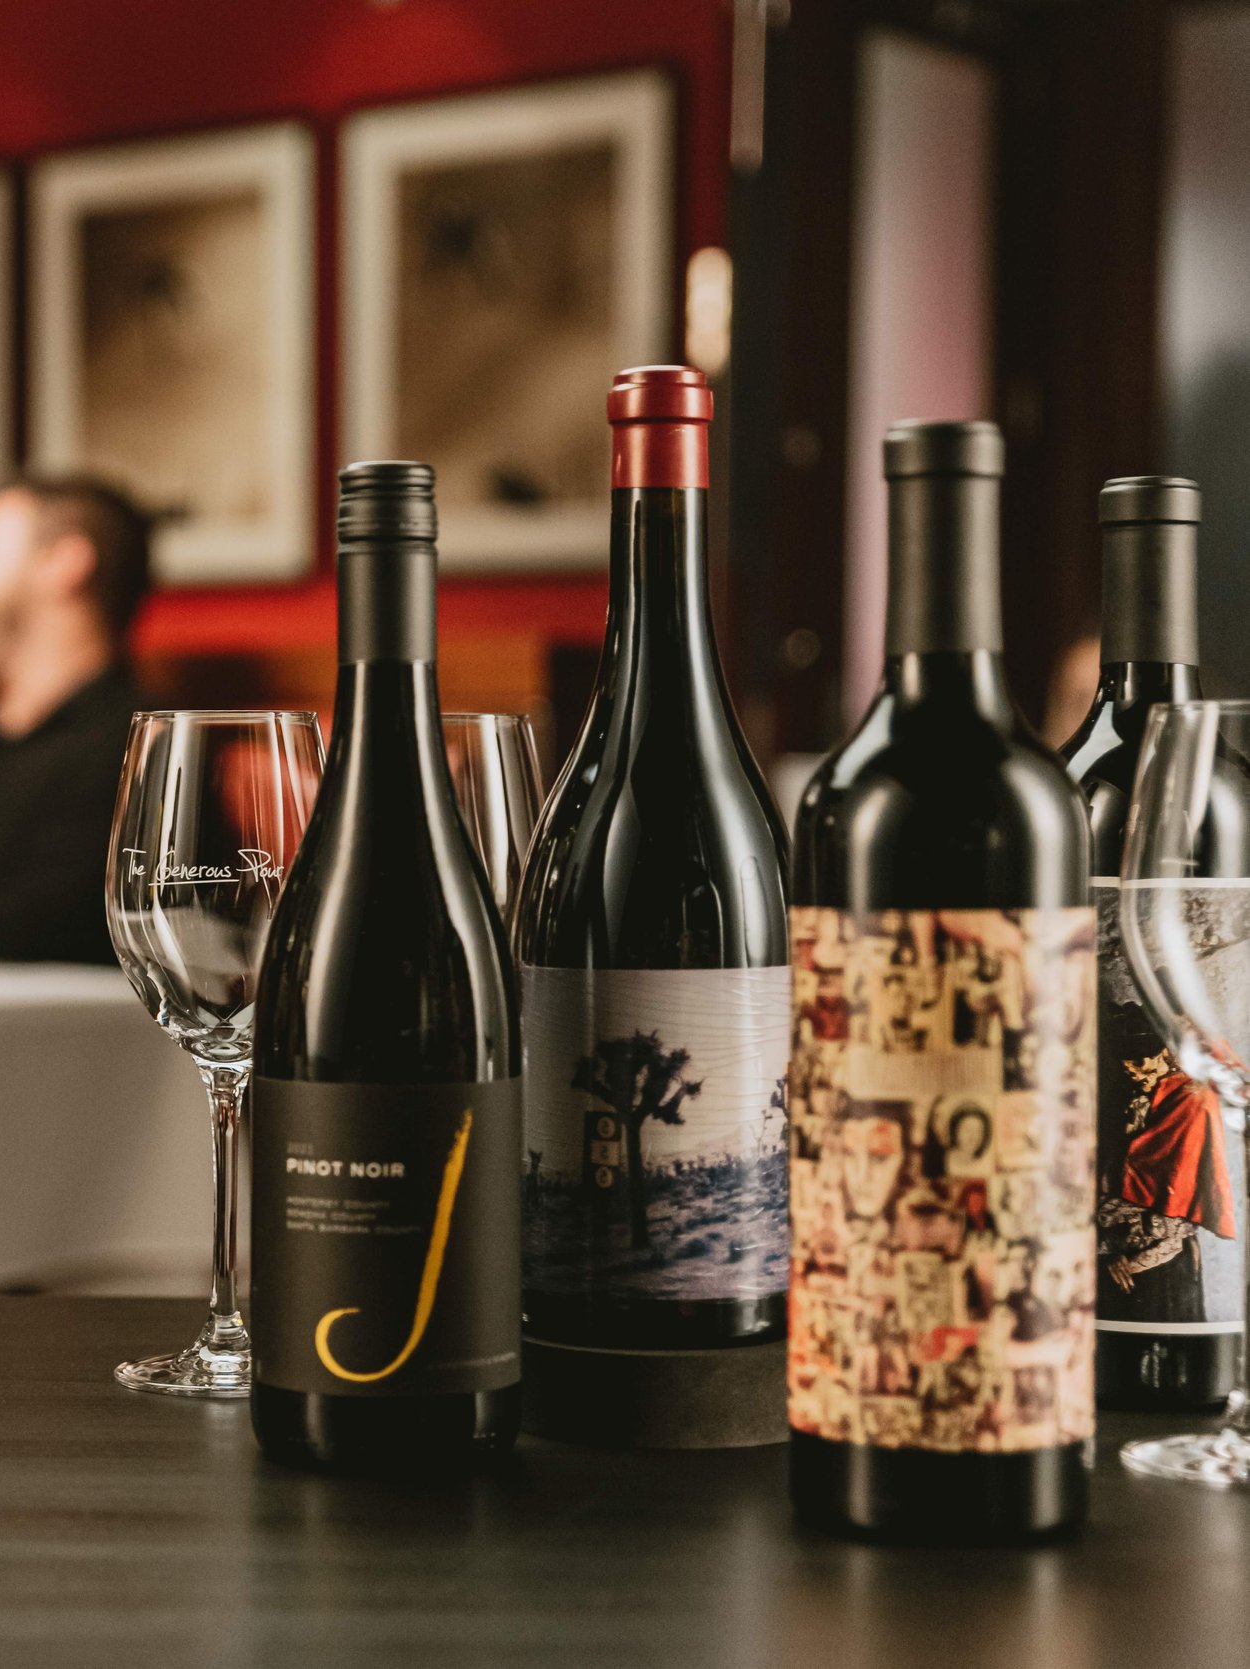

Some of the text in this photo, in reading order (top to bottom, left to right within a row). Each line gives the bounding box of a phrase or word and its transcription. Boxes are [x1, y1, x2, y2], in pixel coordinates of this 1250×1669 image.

[122, 848, 285, 883] The Generous Pour
[286, 1158, 406, 1179] PINOT NOIR
